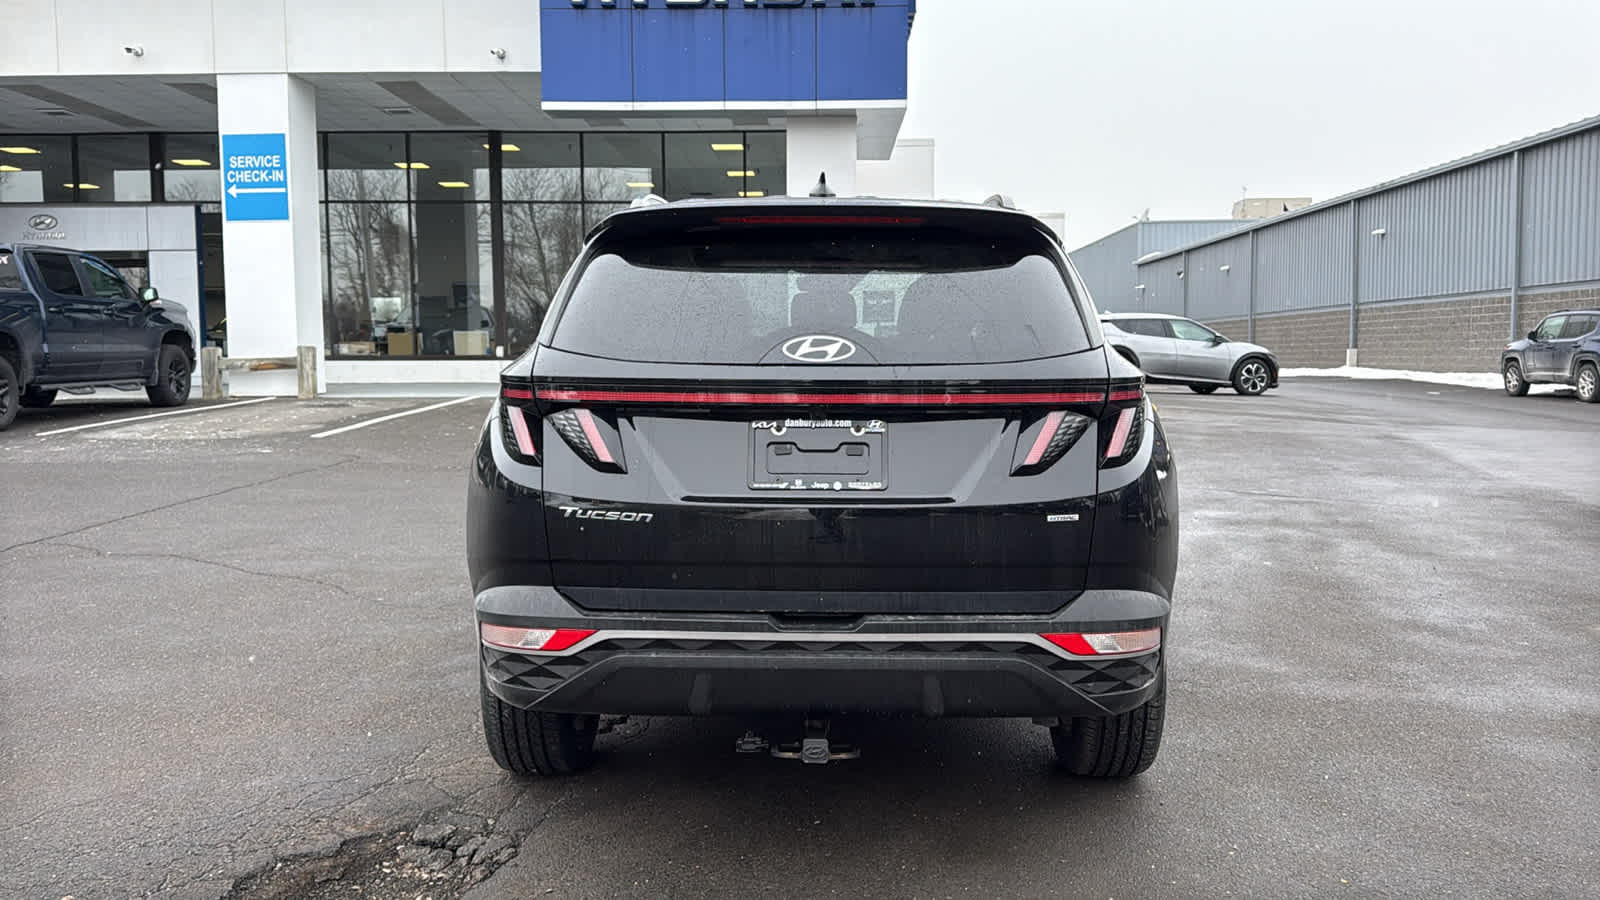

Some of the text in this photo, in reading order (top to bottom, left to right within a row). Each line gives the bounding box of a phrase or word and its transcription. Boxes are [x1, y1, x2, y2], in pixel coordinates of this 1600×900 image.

[229, 155, 281, 168] SERVICE
[227, 169, 284, 183] CHECK-IN
[784, 418, 852, 429] danburyauto.com
